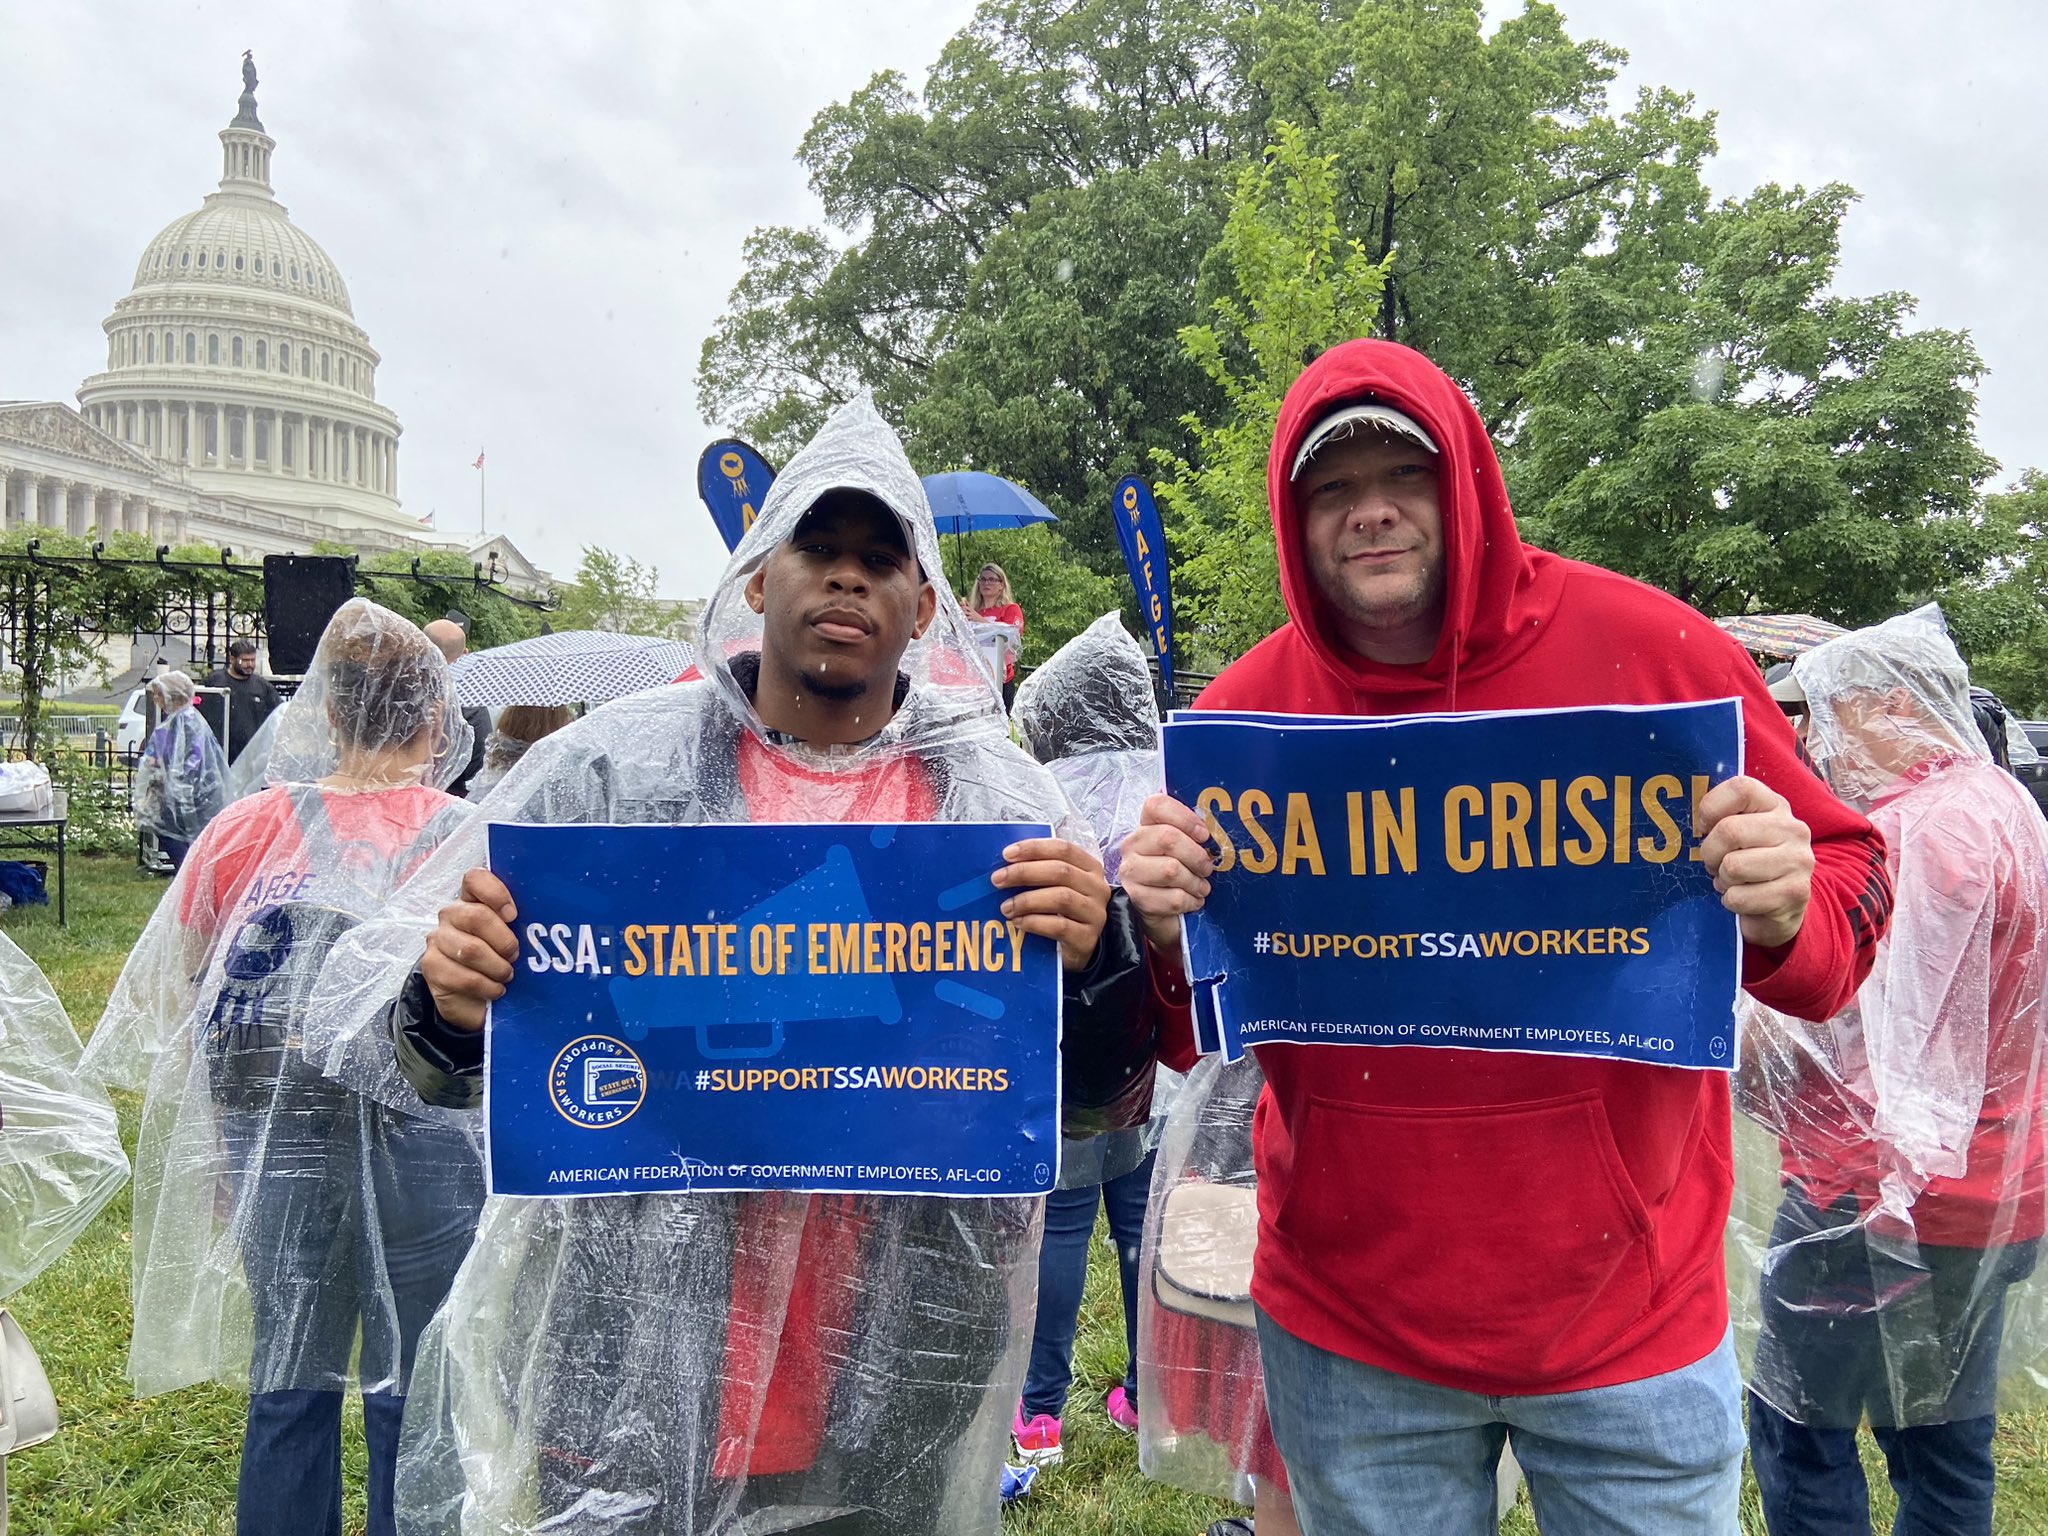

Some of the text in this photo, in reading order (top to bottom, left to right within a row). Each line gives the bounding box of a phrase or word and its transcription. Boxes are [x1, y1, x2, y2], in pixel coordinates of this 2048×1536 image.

[1136, 528, 1168, 654] AFGE
[1196, 774, 1711, 876] SSA IN CRISIS!
[243, 870, 317, 907] AFGE
[526, 919, 1027, 976] SSA: STATE OF EMERGENCY
[1253, 927, 1650, 958] #SUPPORTSSAWORKERS
[1239, 1019, 1675, 1052] AMERICAN FEDERATION OF GOVERNMENT EMPLOYEES, AFL-CIO
[556, 1041, 624, 1122] #SUPPORTSSAWORKERS
[695, 1066, 1009, 1092] #SUPPORTSSAWORKERS
[548, 1165, 1001, 1183] AMERICAN FEDERATION OF GOVERNMENT EMPLOYEES, AFL-CIO
